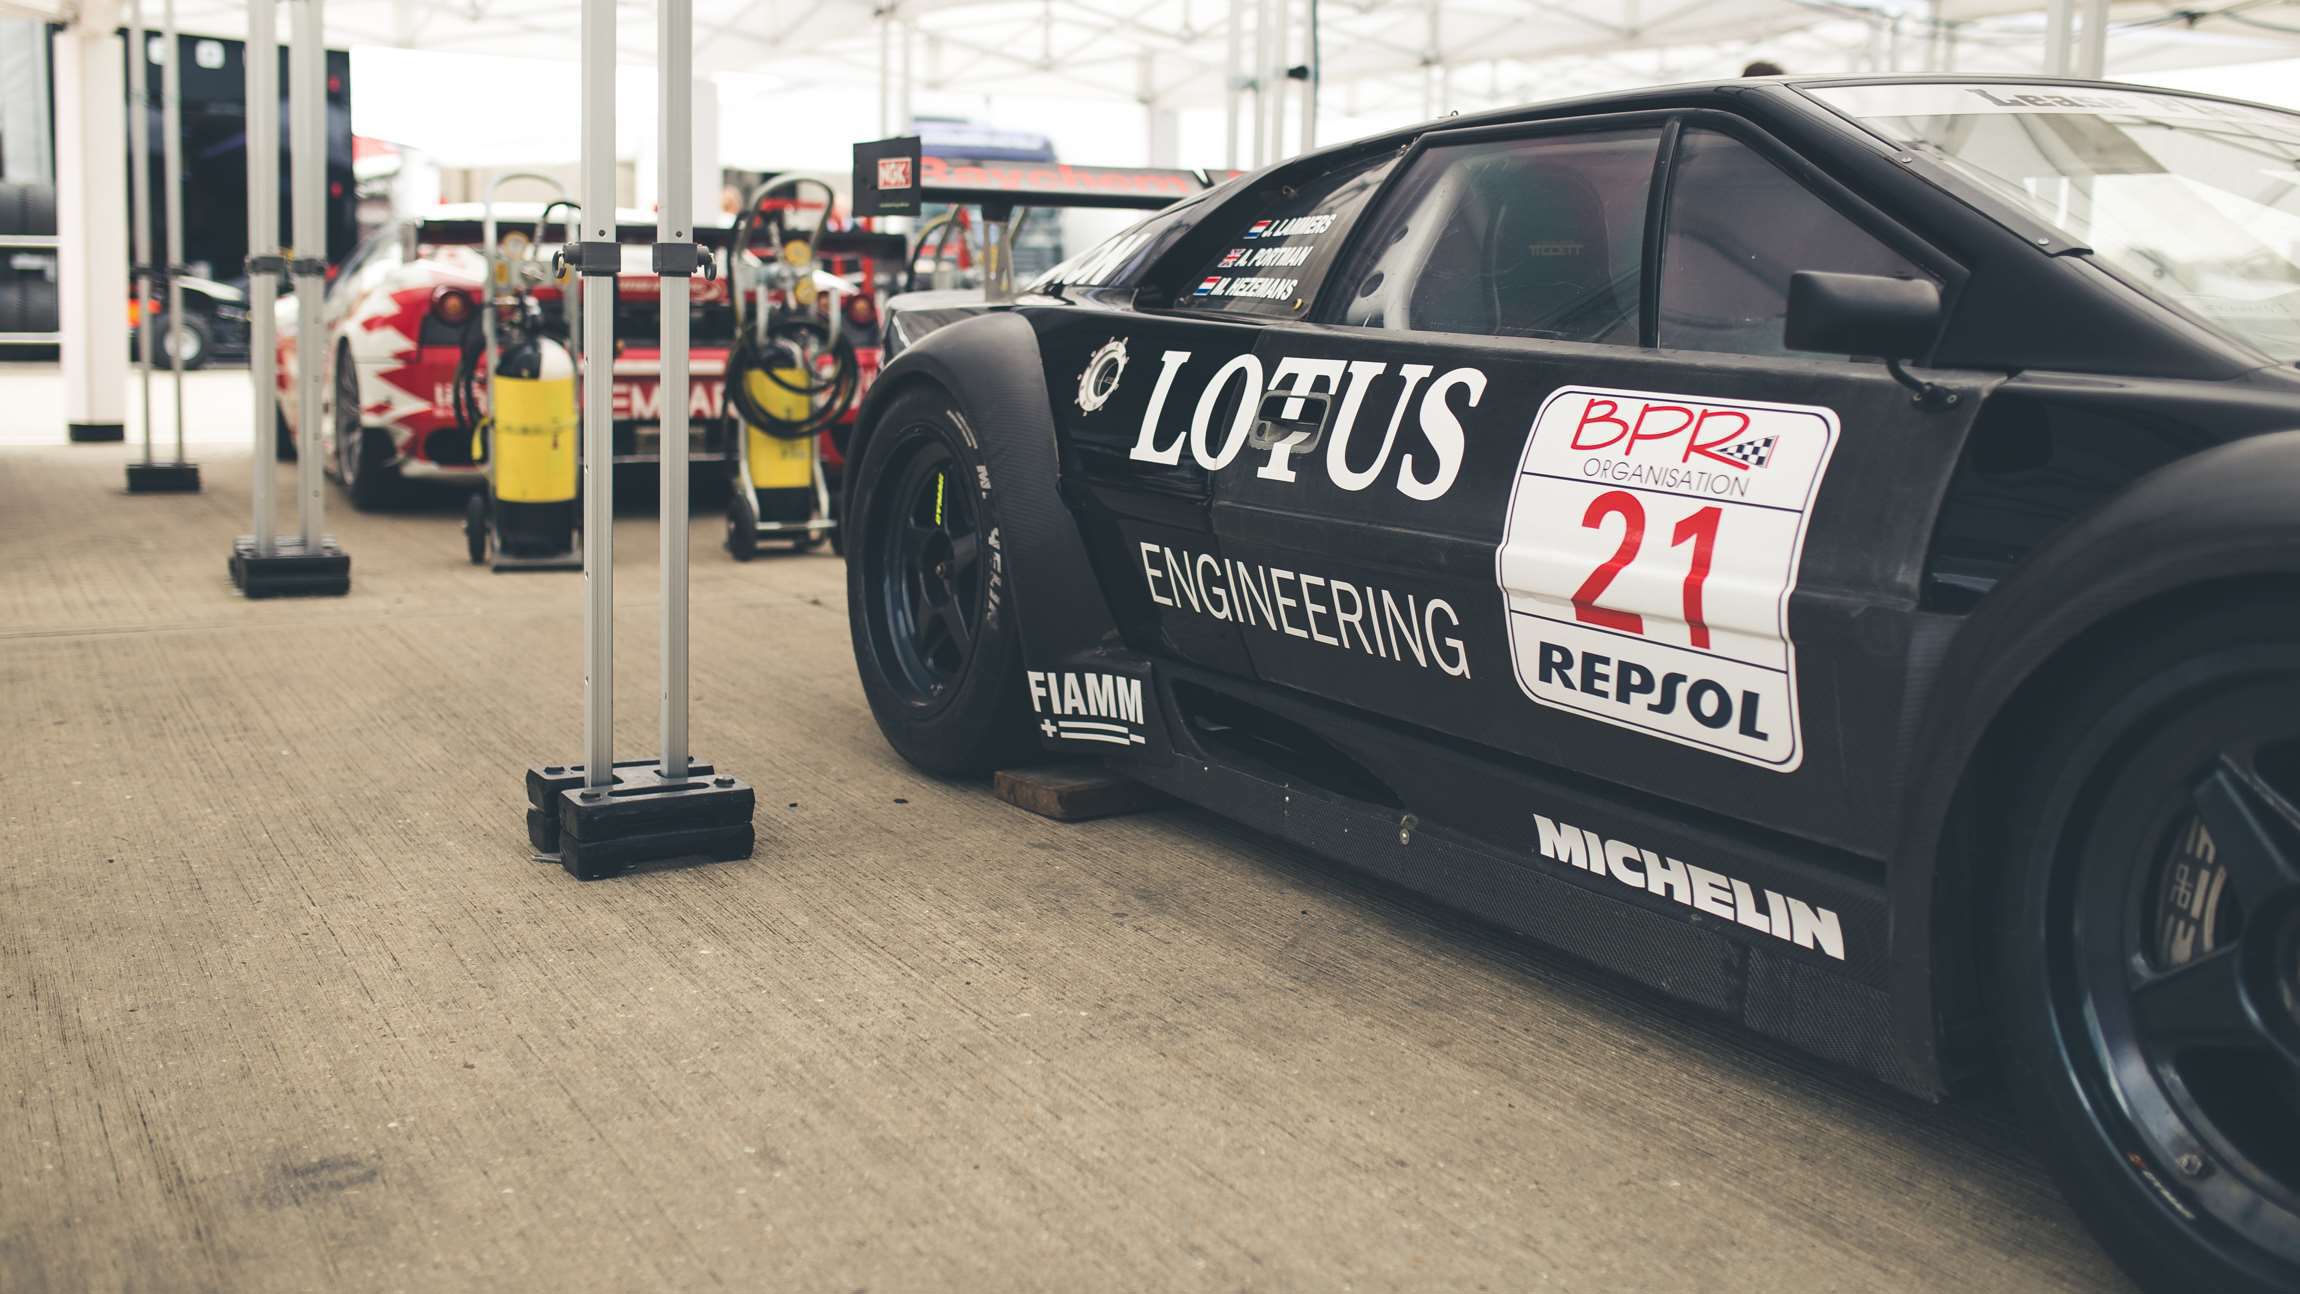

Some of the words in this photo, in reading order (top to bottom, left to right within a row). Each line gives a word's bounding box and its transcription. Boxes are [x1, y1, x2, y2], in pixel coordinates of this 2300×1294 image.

[1247, 246, 1314, 267] PORTMAN
[1272, 214, 1336, 237] LAMMERS
[1225, 277, 1298, 300] HEZEMANS
[1129, 350, 1488, 501] LOTUS
[1570, 398, 1750, 471] BPR
[1583, 458, 1750, 498] ORGANISATION
[1570, 490, 1722, 650] 21
[1139, 541, 1471, 680] ENGINEERING
[1027, 670, 1145, 725] FIAMM
[1538, 640, 1769, 742] REPSOL
[1532, 813, 1845, 961] MICHELIN
